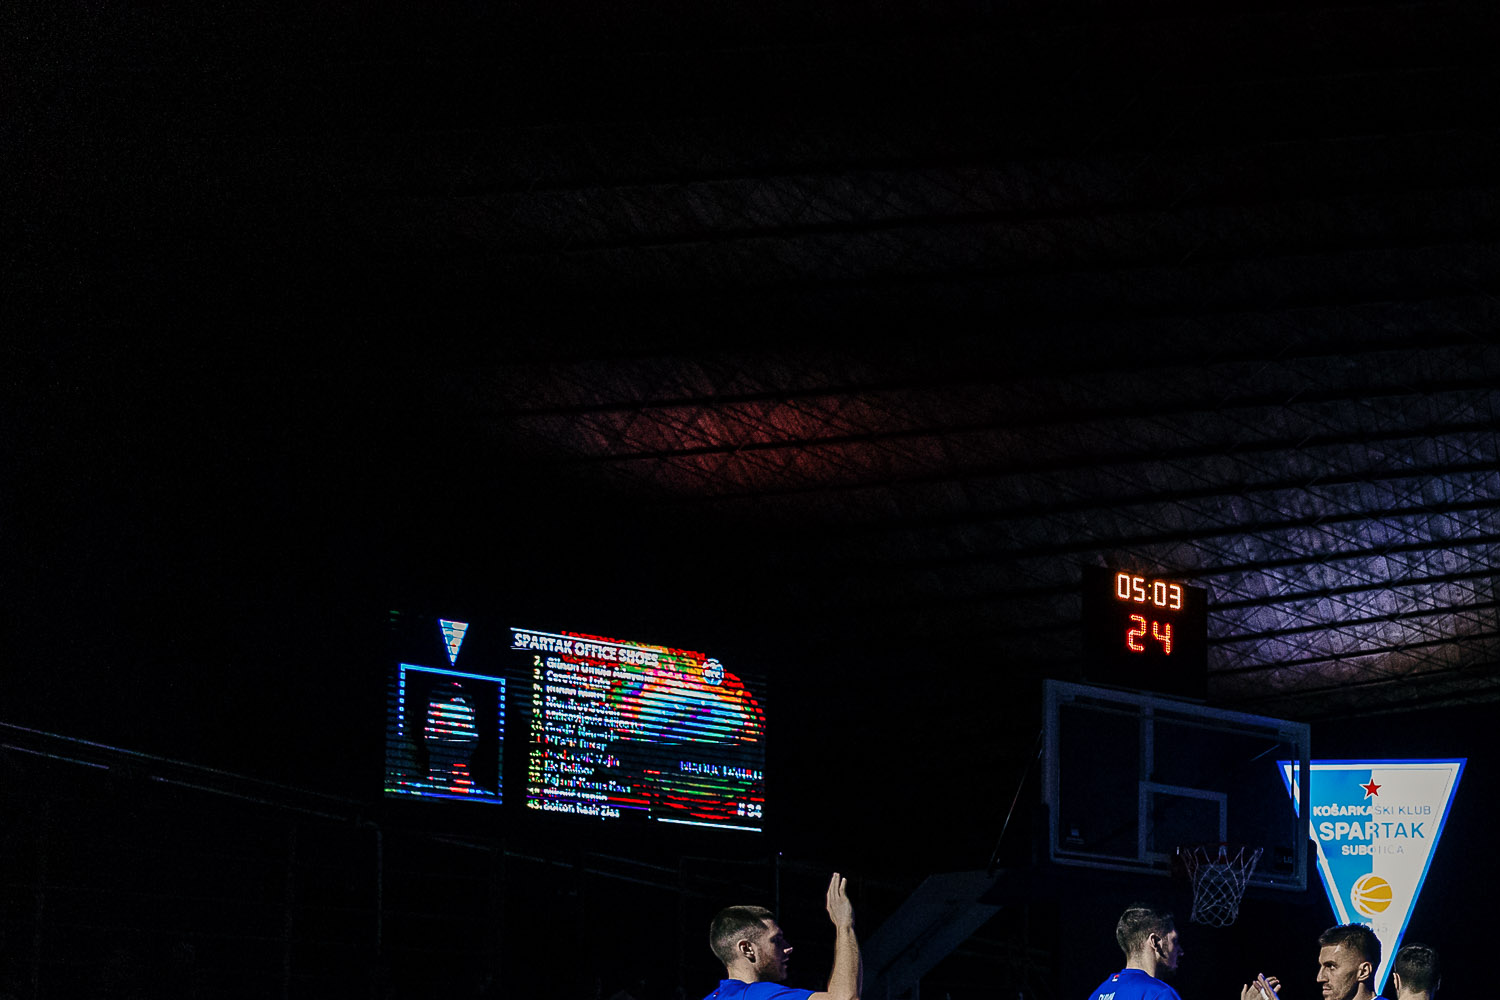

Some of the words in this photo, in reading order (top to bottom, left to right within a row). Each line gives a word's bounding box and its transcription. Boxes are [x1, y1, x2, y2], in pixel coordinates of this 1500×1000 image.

[1117, 573, 1181, 610] 05:03
[514, 633, 573, 655] SPARTAK
[574, 642, 617, 661] OFFICE
[618, 648, 659, 667] SHOES
[1128, 614, 1171, 654] 24
[1398, 805, 1431, 816] KLUB
[1319, 822, 1425, 841] SPARTAK
